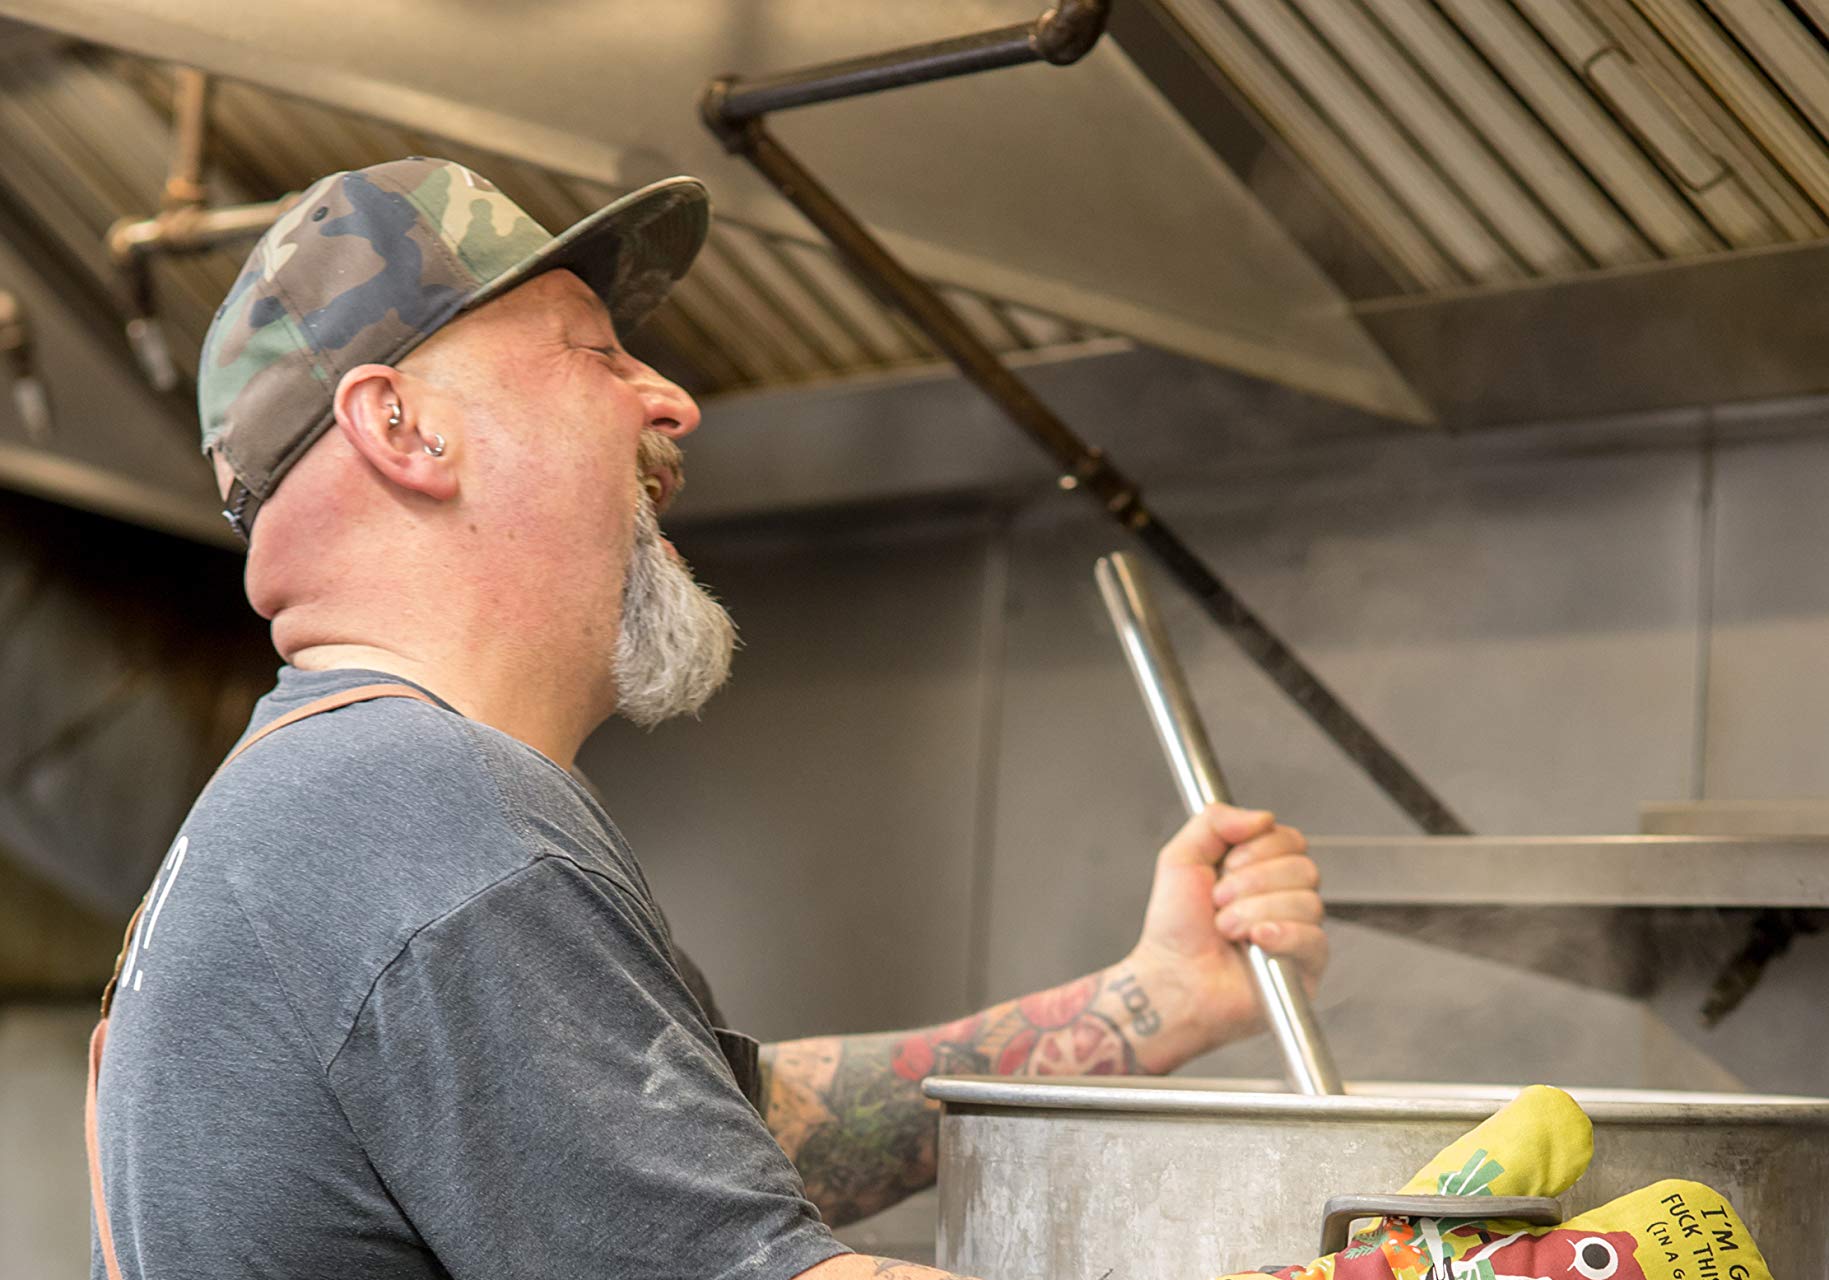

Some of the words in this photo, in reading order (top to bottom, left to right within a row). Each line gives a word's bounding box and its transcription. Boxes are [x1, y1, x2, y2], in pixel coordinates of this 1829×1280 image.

[1661, 1193, 1703, 1238] FUCK
[1701, 1205, 1738, 1251] I'M
[1646, 1221, 1673, 1246] (IN
[1665, 1251, 1679, 1262] A
